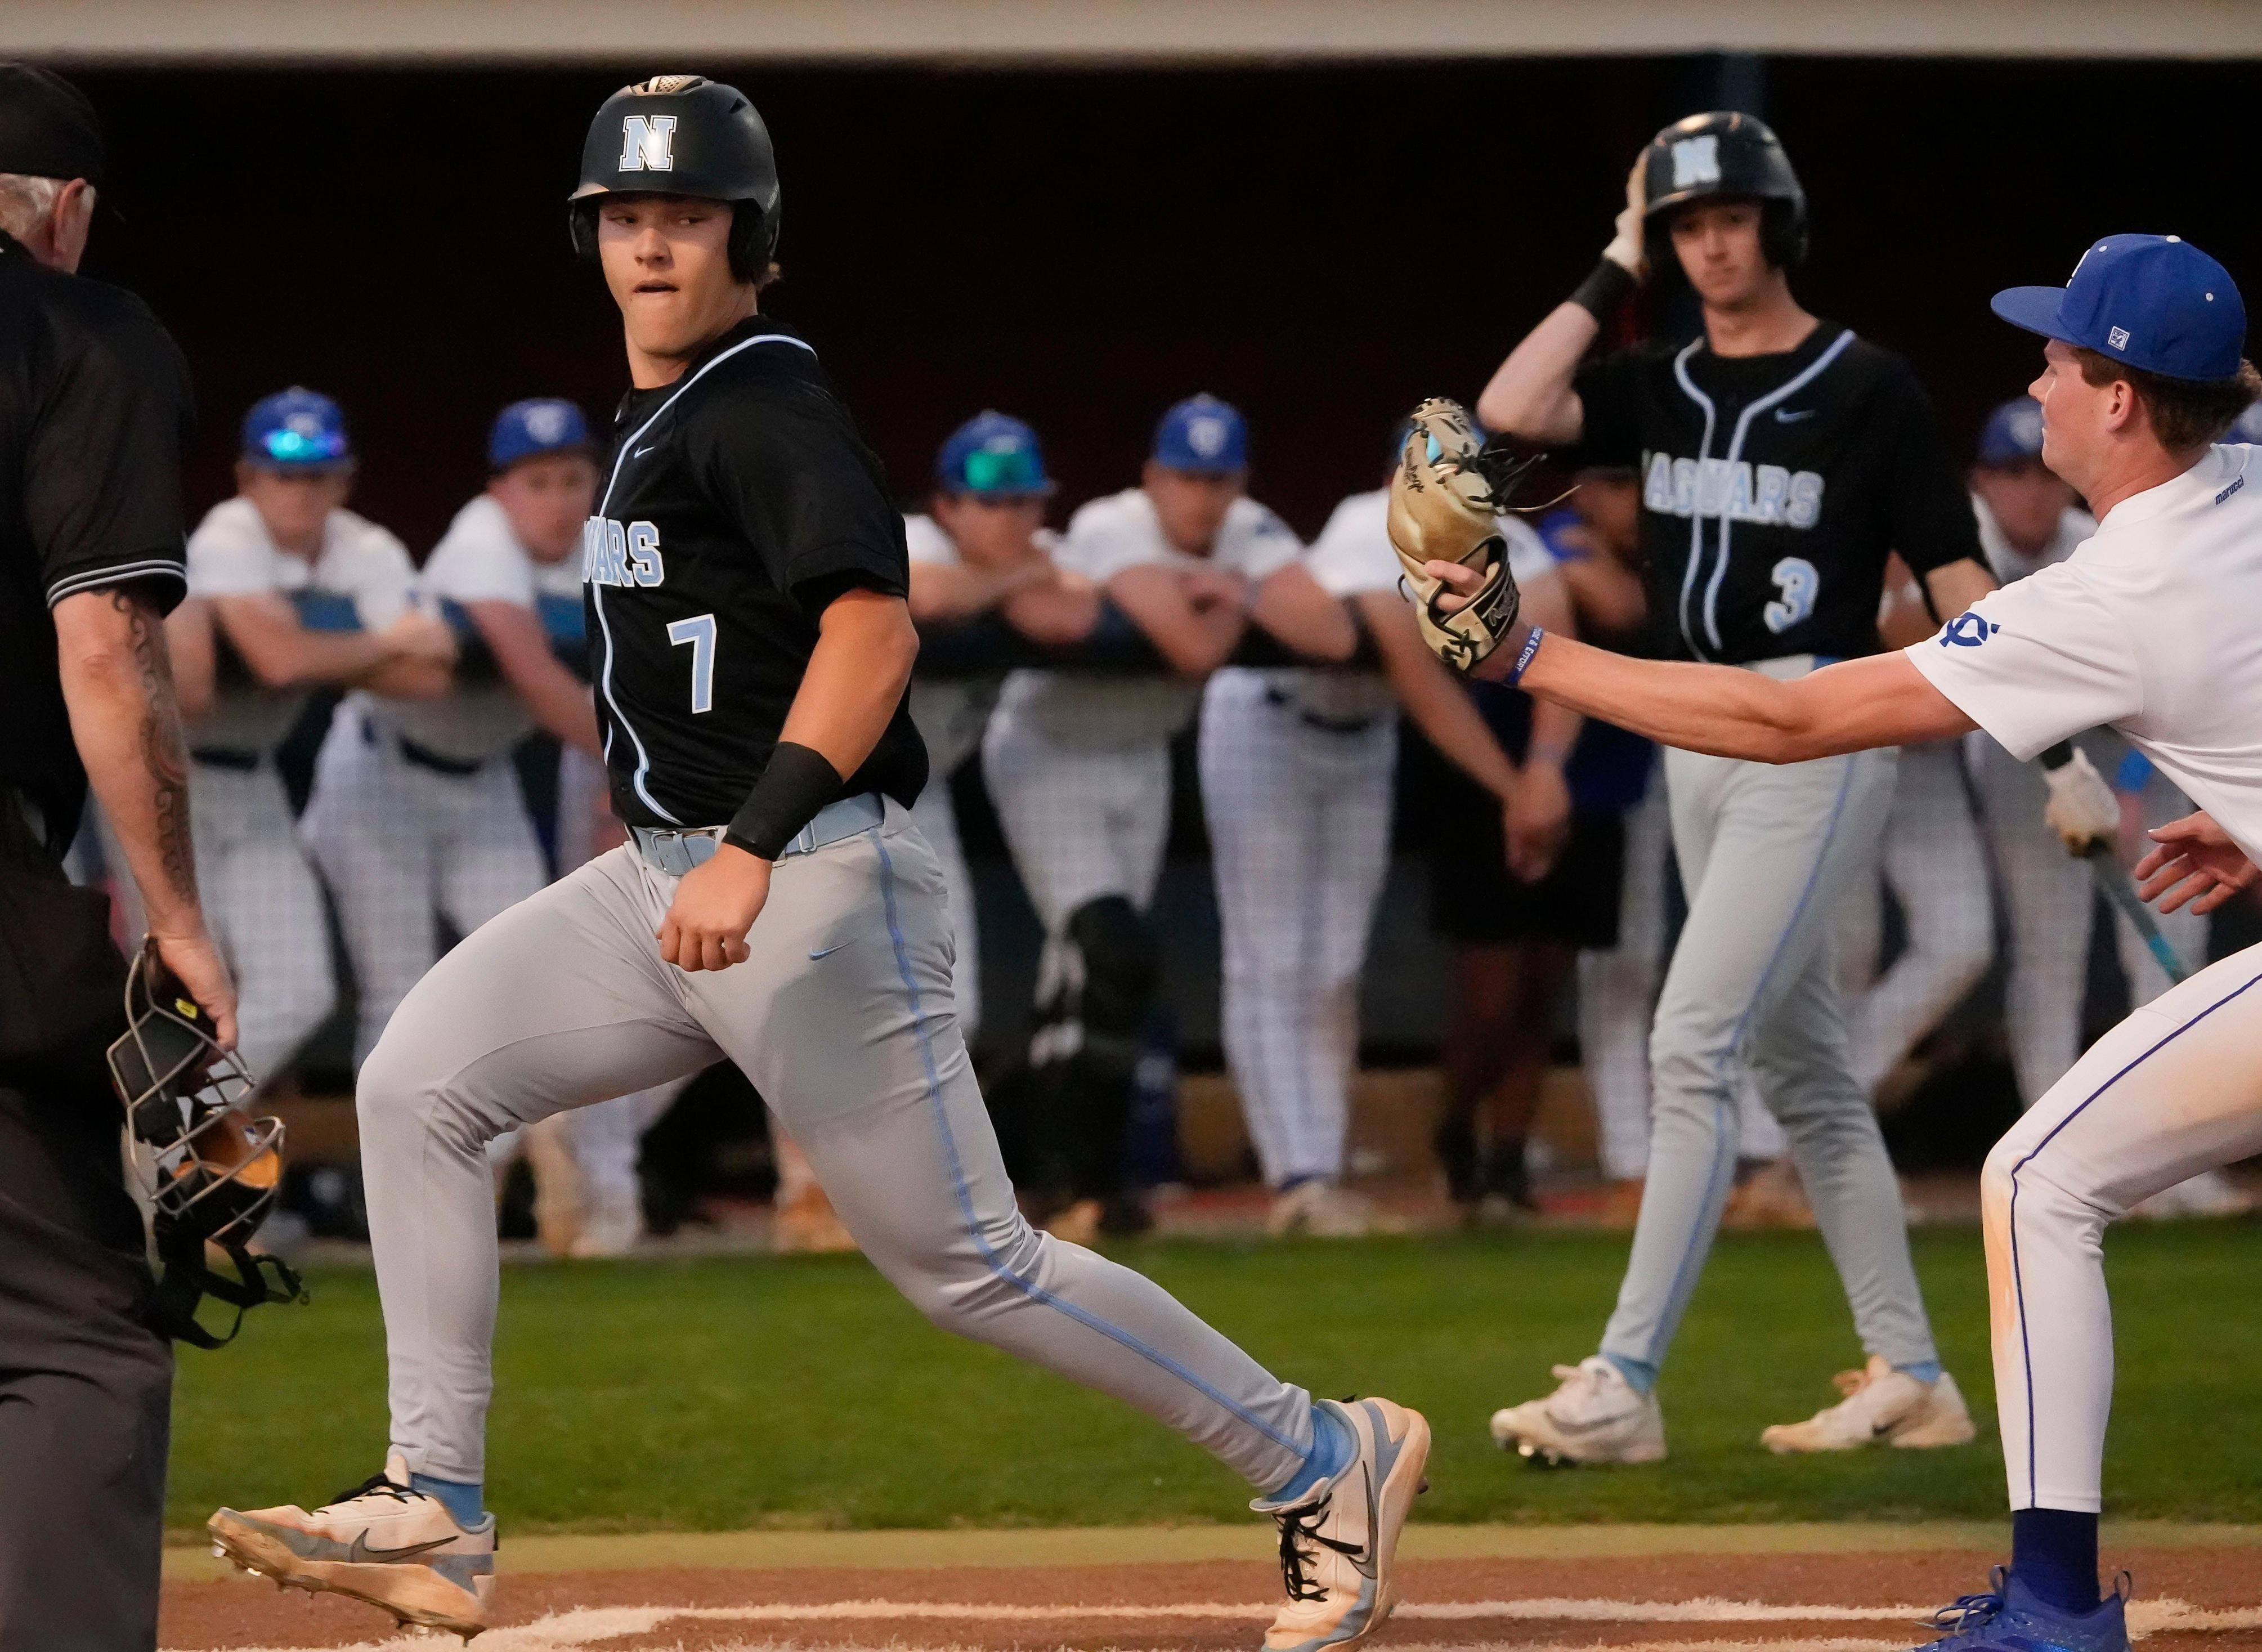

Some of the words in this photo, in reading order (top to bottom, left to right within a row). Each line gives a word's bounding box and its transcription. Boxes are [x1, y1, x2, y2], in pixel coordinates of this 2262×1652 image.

[619, 115, 677, 171] N
[1642, 449, 1825, 530] AGUARS
[2215, 474, 2245, 505] marucci
[1763, 556, 1819, 635] 3
[666, 614, 717, 714] 7
[1515, 647, 1534, 671] EFFORT
